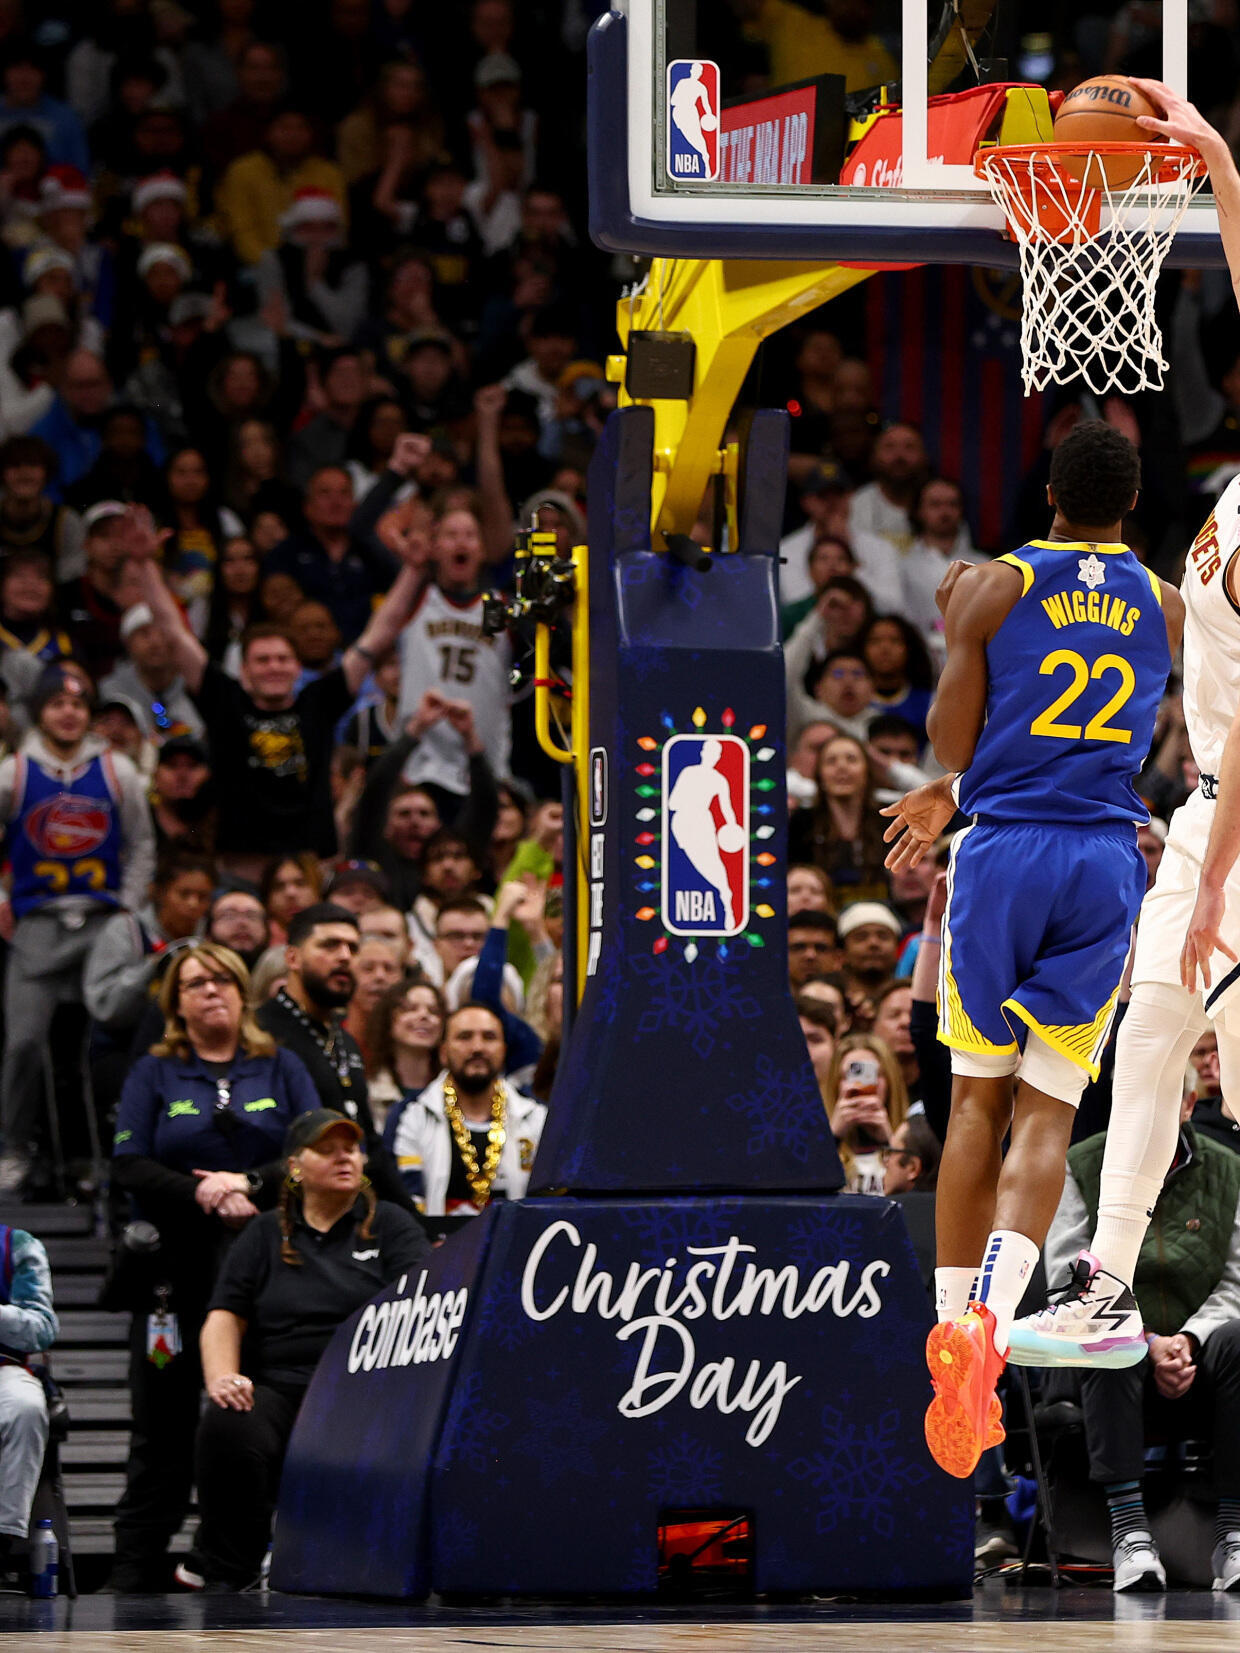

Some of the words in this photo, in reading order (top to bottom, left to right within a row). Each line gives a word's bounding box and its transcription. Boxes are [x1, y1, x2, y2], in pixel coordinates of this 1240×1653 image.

[675, 153, 700, 173] NBA
[1040, 590, 1141, 637] WIGGINS
[438, 644, 478, 686] 15
[1029, 648, 1136, 744] 22
[675, 890, 716, 922] NBA
[521, 1220, 891, 1321] Christmas
[347, 1269, 468, 1374] coinbase
[616, 1315, 803, 1447] Day
